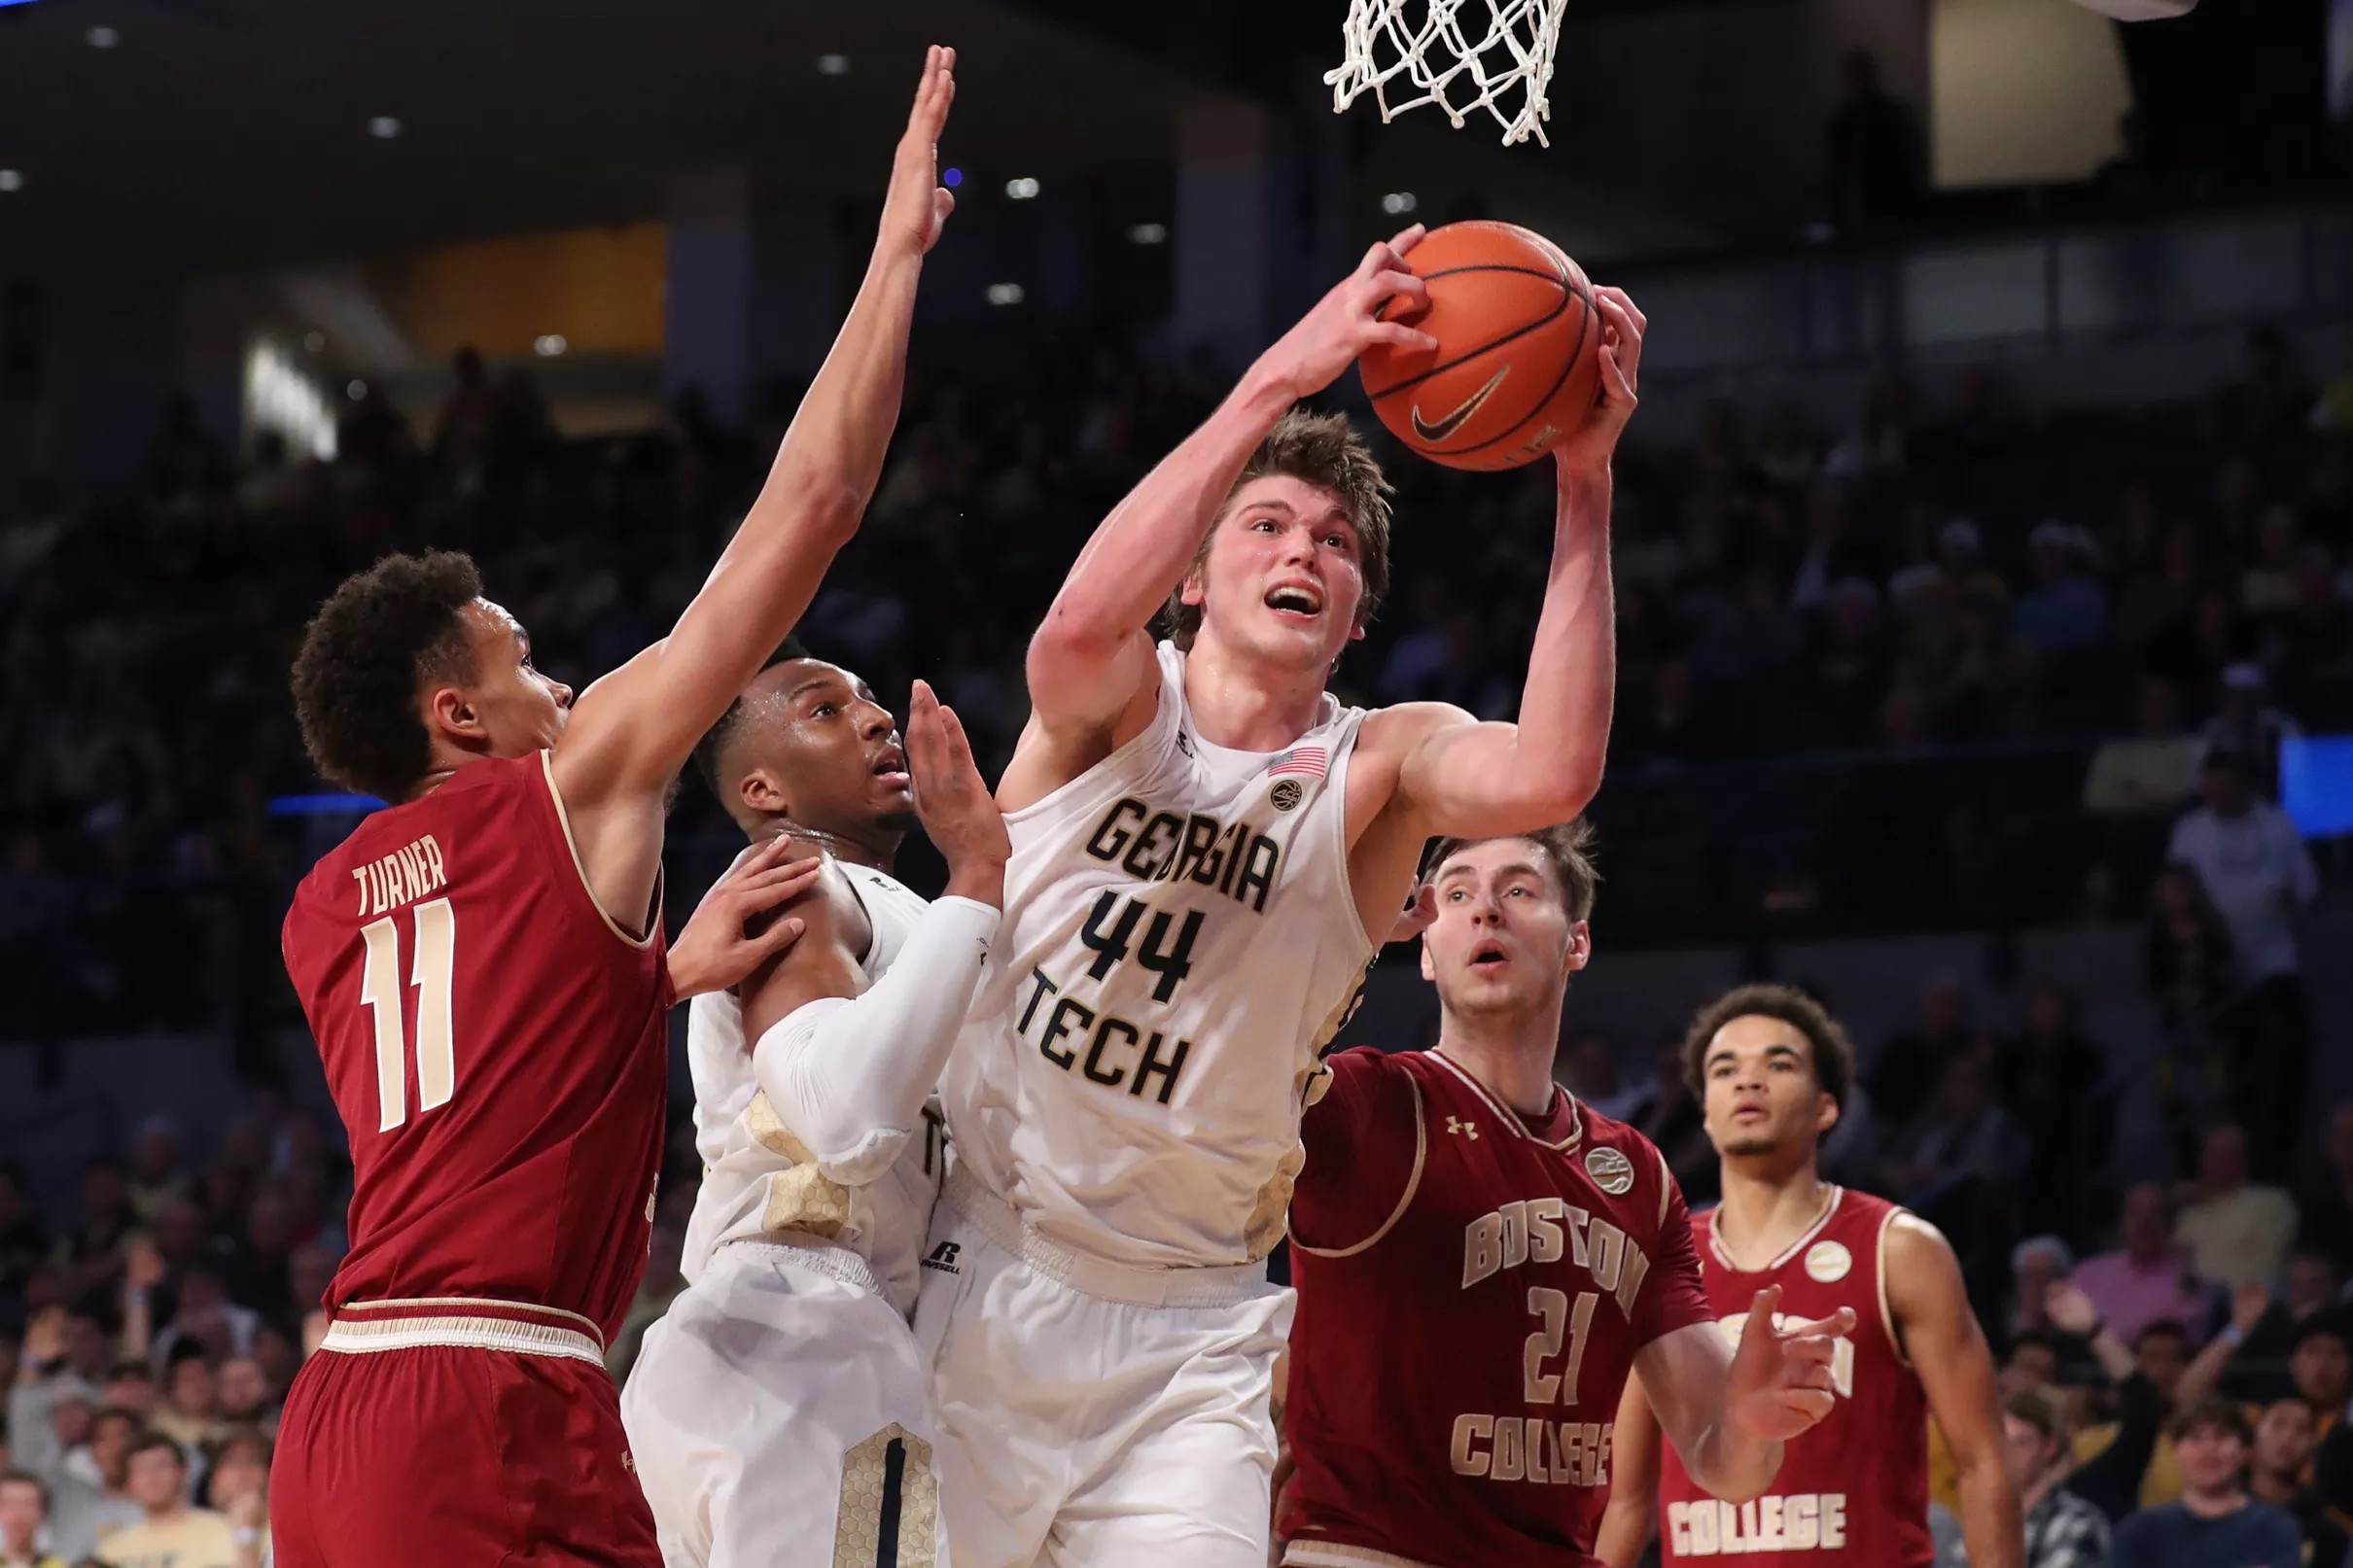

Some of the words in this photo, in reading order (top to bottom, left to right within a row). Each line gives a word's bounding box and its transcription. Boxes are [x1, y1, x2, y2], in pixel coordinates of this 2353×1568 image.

[352, 834, 447, 917] TURNER
[1081, 889, 1207, 1004] 44
[359, 896, 456, 1134] 11
[1017, 966, 1191, 1104] TECH
[1461, 1197, 1651, 1325] BOSTON
[1524, 1285, 1600, 1407] 21
[1451, 1412, 1614, 1487] COLLEGE
[1667, 1493, 1847, 1557] COLLEGE
